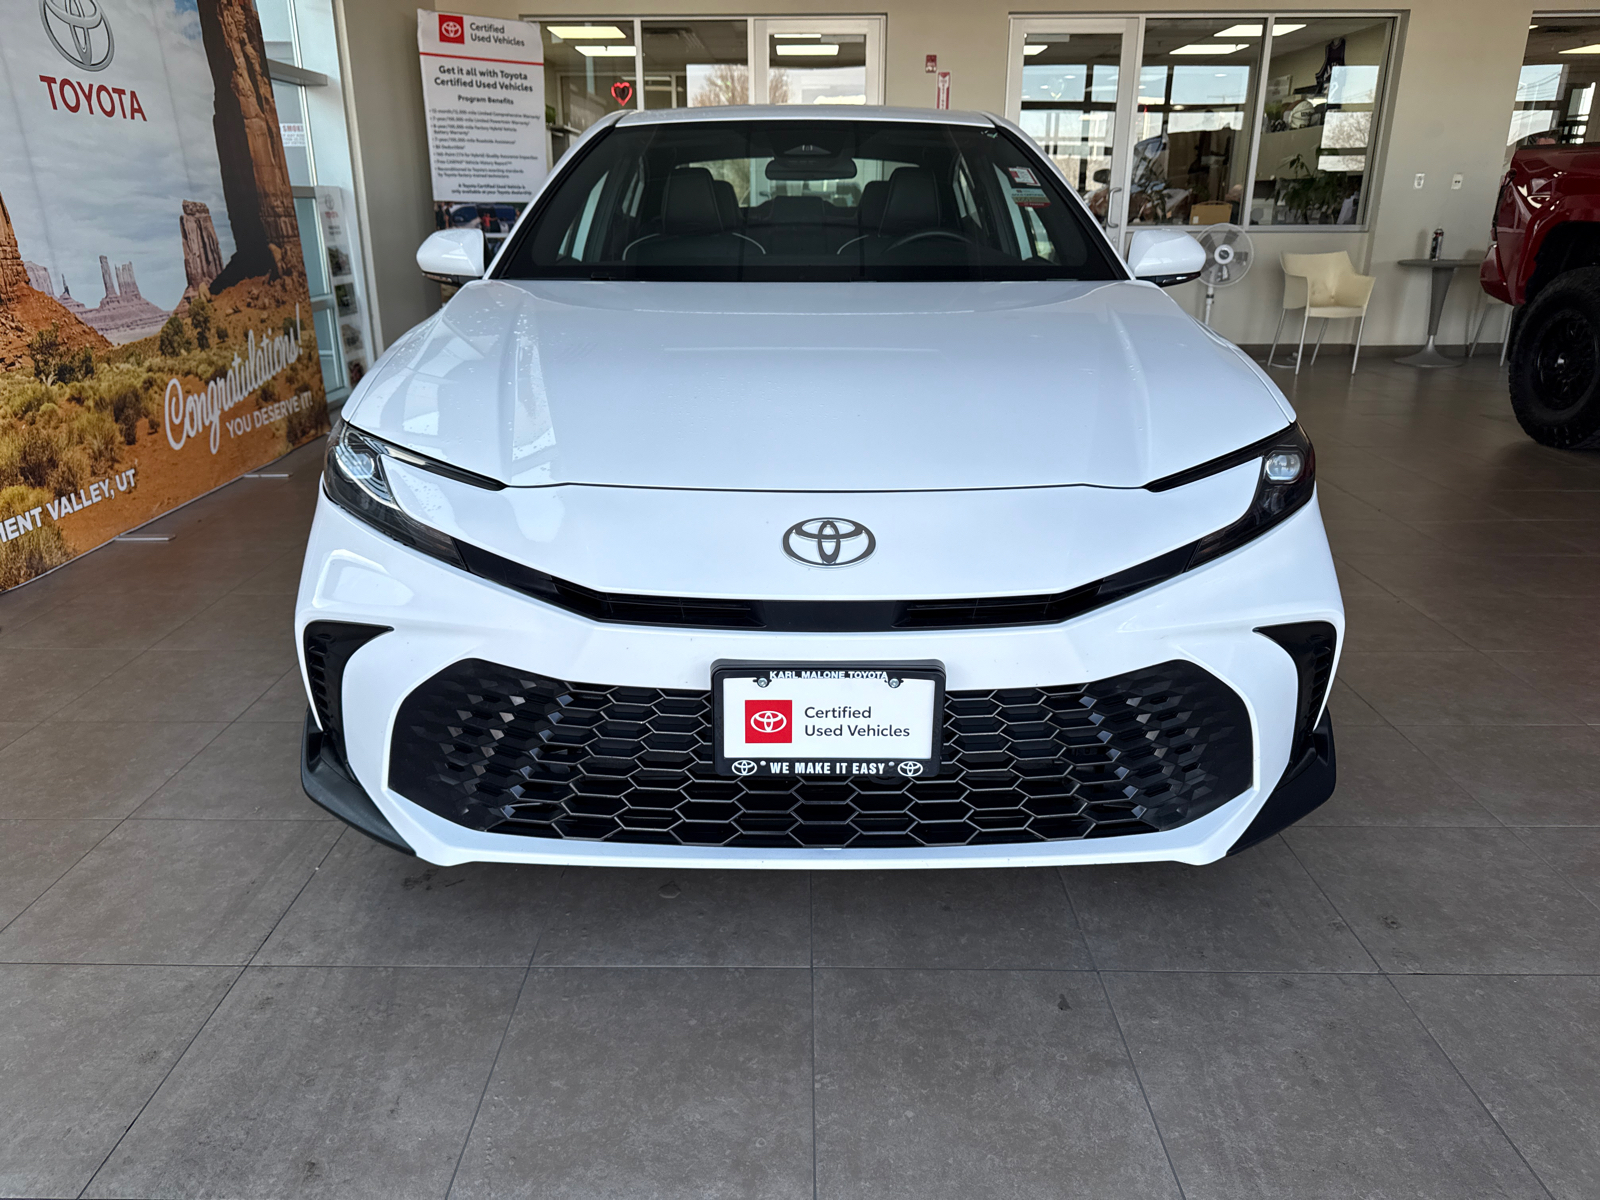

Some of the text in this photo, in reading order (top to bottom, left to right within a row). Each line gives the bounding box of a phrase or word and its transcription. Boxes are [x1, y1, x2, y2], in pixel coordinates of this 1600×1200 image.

[470, 22, 504, 34] Certified
[470, 34, 525, 46] Used Vehicles
[439, 66, 528, 81] Get it all with Toyota
[434, 77, 533, 92] Certified Used Vehicles
[39, 75, 148, 122] TOYOTA
[458, 95, 514, 106] Program Benefits
[165, 302, 302, 454] Congratulations!
[226, 390, 314, 438] YOU DESERVE IT!
[46, 478, 114, 521] VALLEY,
[116, 468, 135, 492] UT
[770, 671, 888, 680] KARL MALONE TOYOTA
[804, 706, 872, 719] Certified
[804, 724, 910, 737] Used Vehicles
[770, 762, 885, 775] WE MAKE IT EASY
